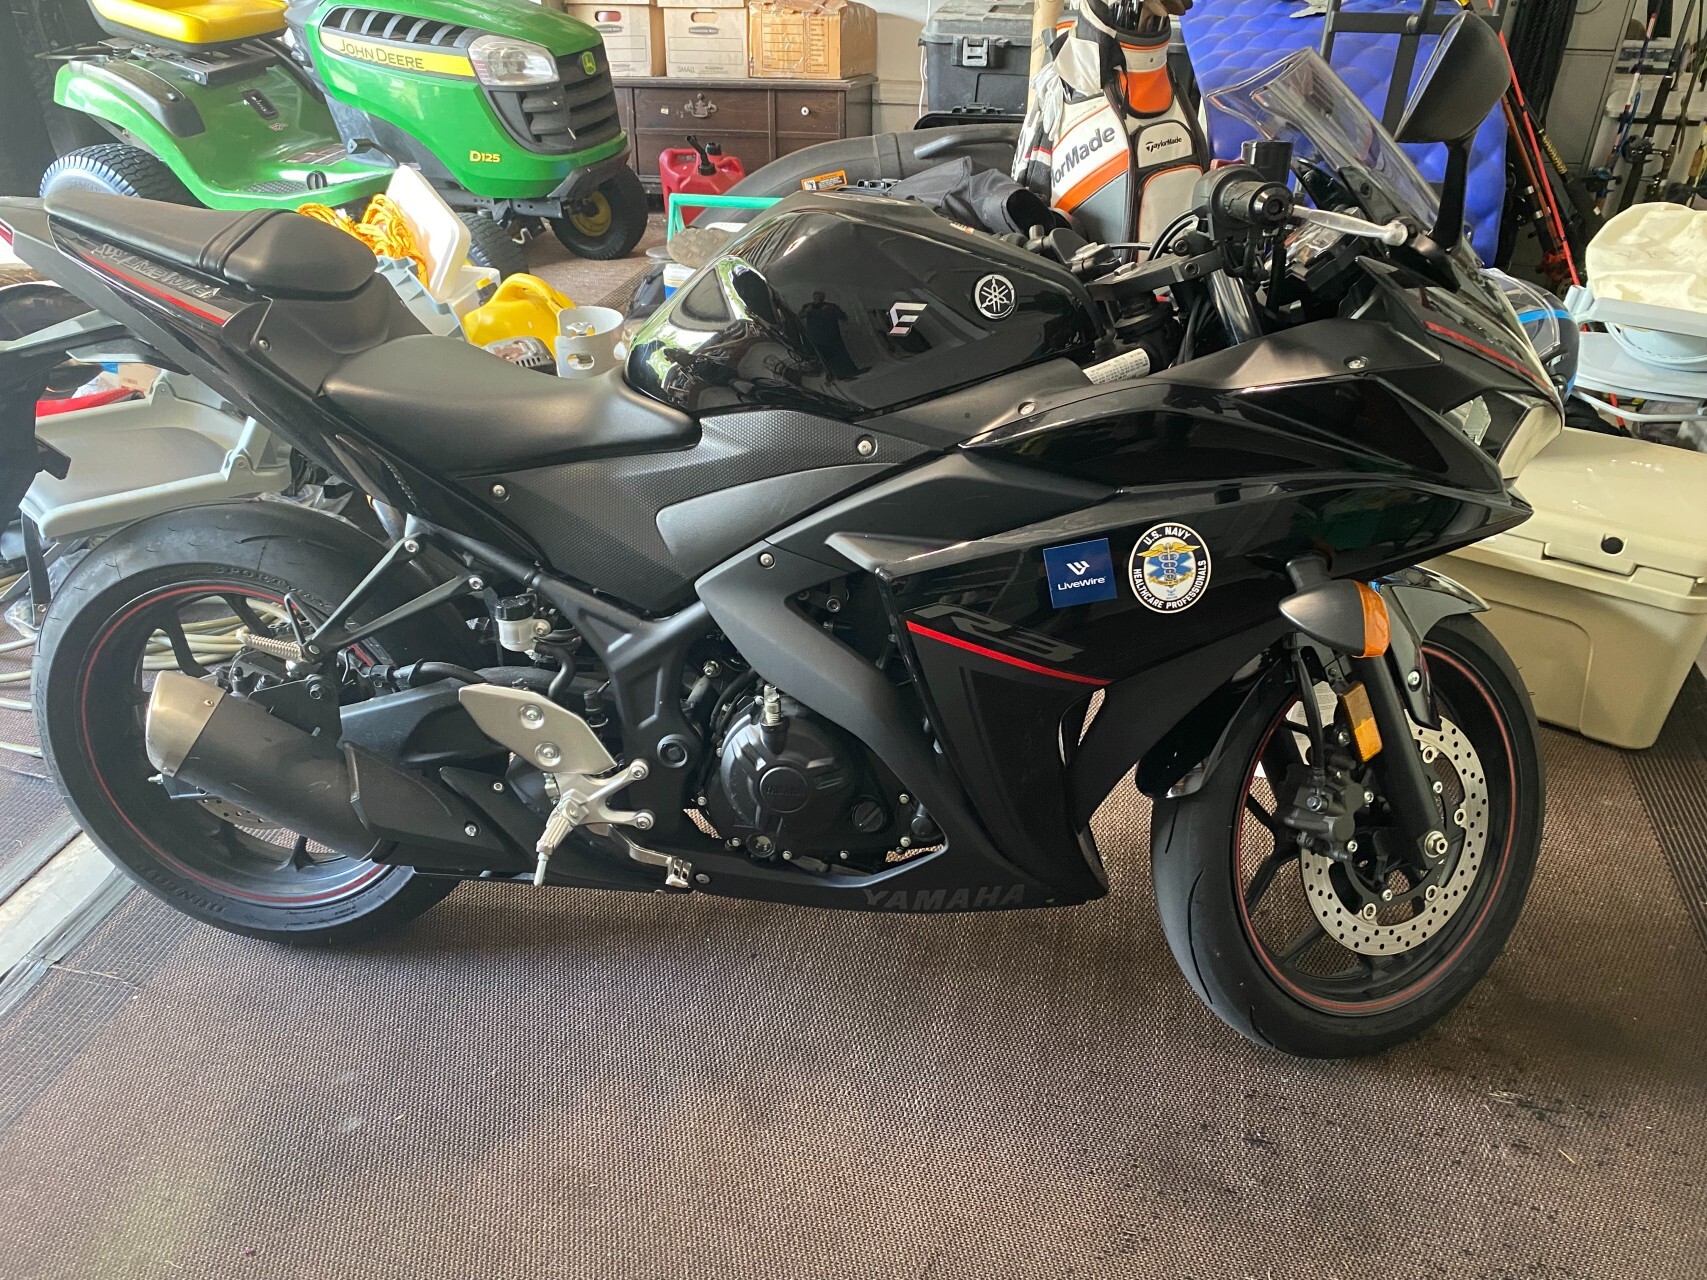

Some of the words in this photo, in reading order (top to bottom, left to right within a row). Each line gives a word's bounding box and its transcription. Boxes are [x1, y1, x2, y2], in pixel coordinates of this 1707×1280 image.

[340, 39, 375, 60] JOHN
[376, 48, 425, 69] DEERE
[1145, 136, 1183, 152] TaylorMade
[470, 150, 501, 163] D125
[1143, 530, 1163, 545] U.S.
[1165, 527, 1192, 540] NAVY
[1057, 576, 1106, 591] LiveWire
[1133, 568, 1164, 609] HEALTHCARE
[1166, 559, 1207, 609] PROFESSIONALS
[862, 884, 1026, 911] YAMAHA
